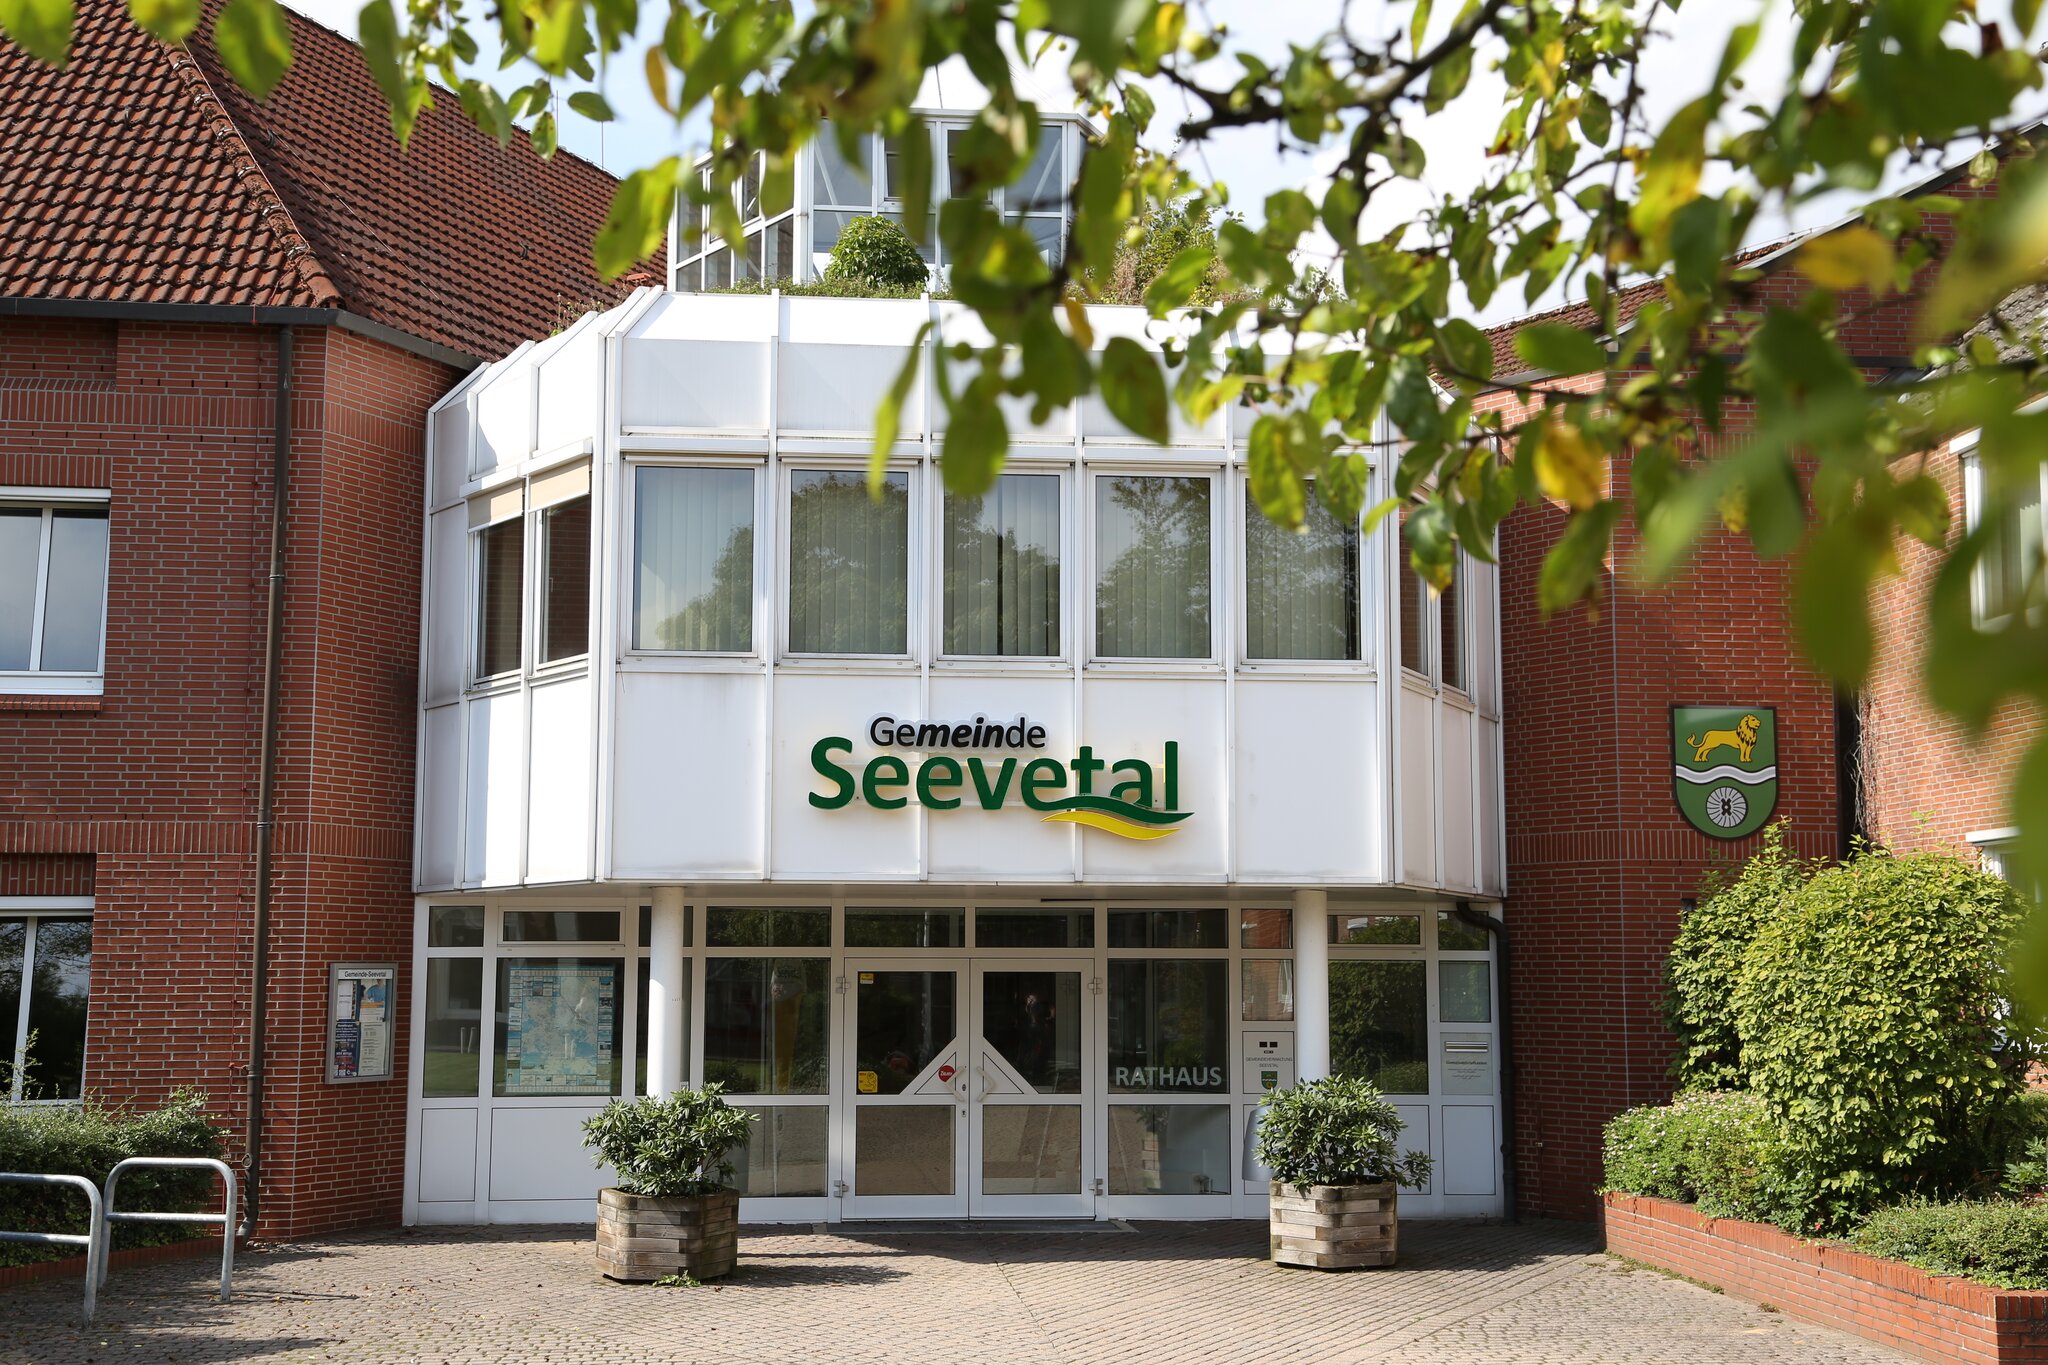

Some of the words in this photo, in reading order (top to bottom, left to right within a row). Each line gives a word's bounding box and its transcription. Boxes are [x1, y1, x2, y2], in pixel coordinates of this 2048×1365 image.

[870, 717, 1046, 748] Gemeinde
[808, 736, 1180, 812] Seevetal
[1115, 1067, 1222, 1086] RATHAUS
